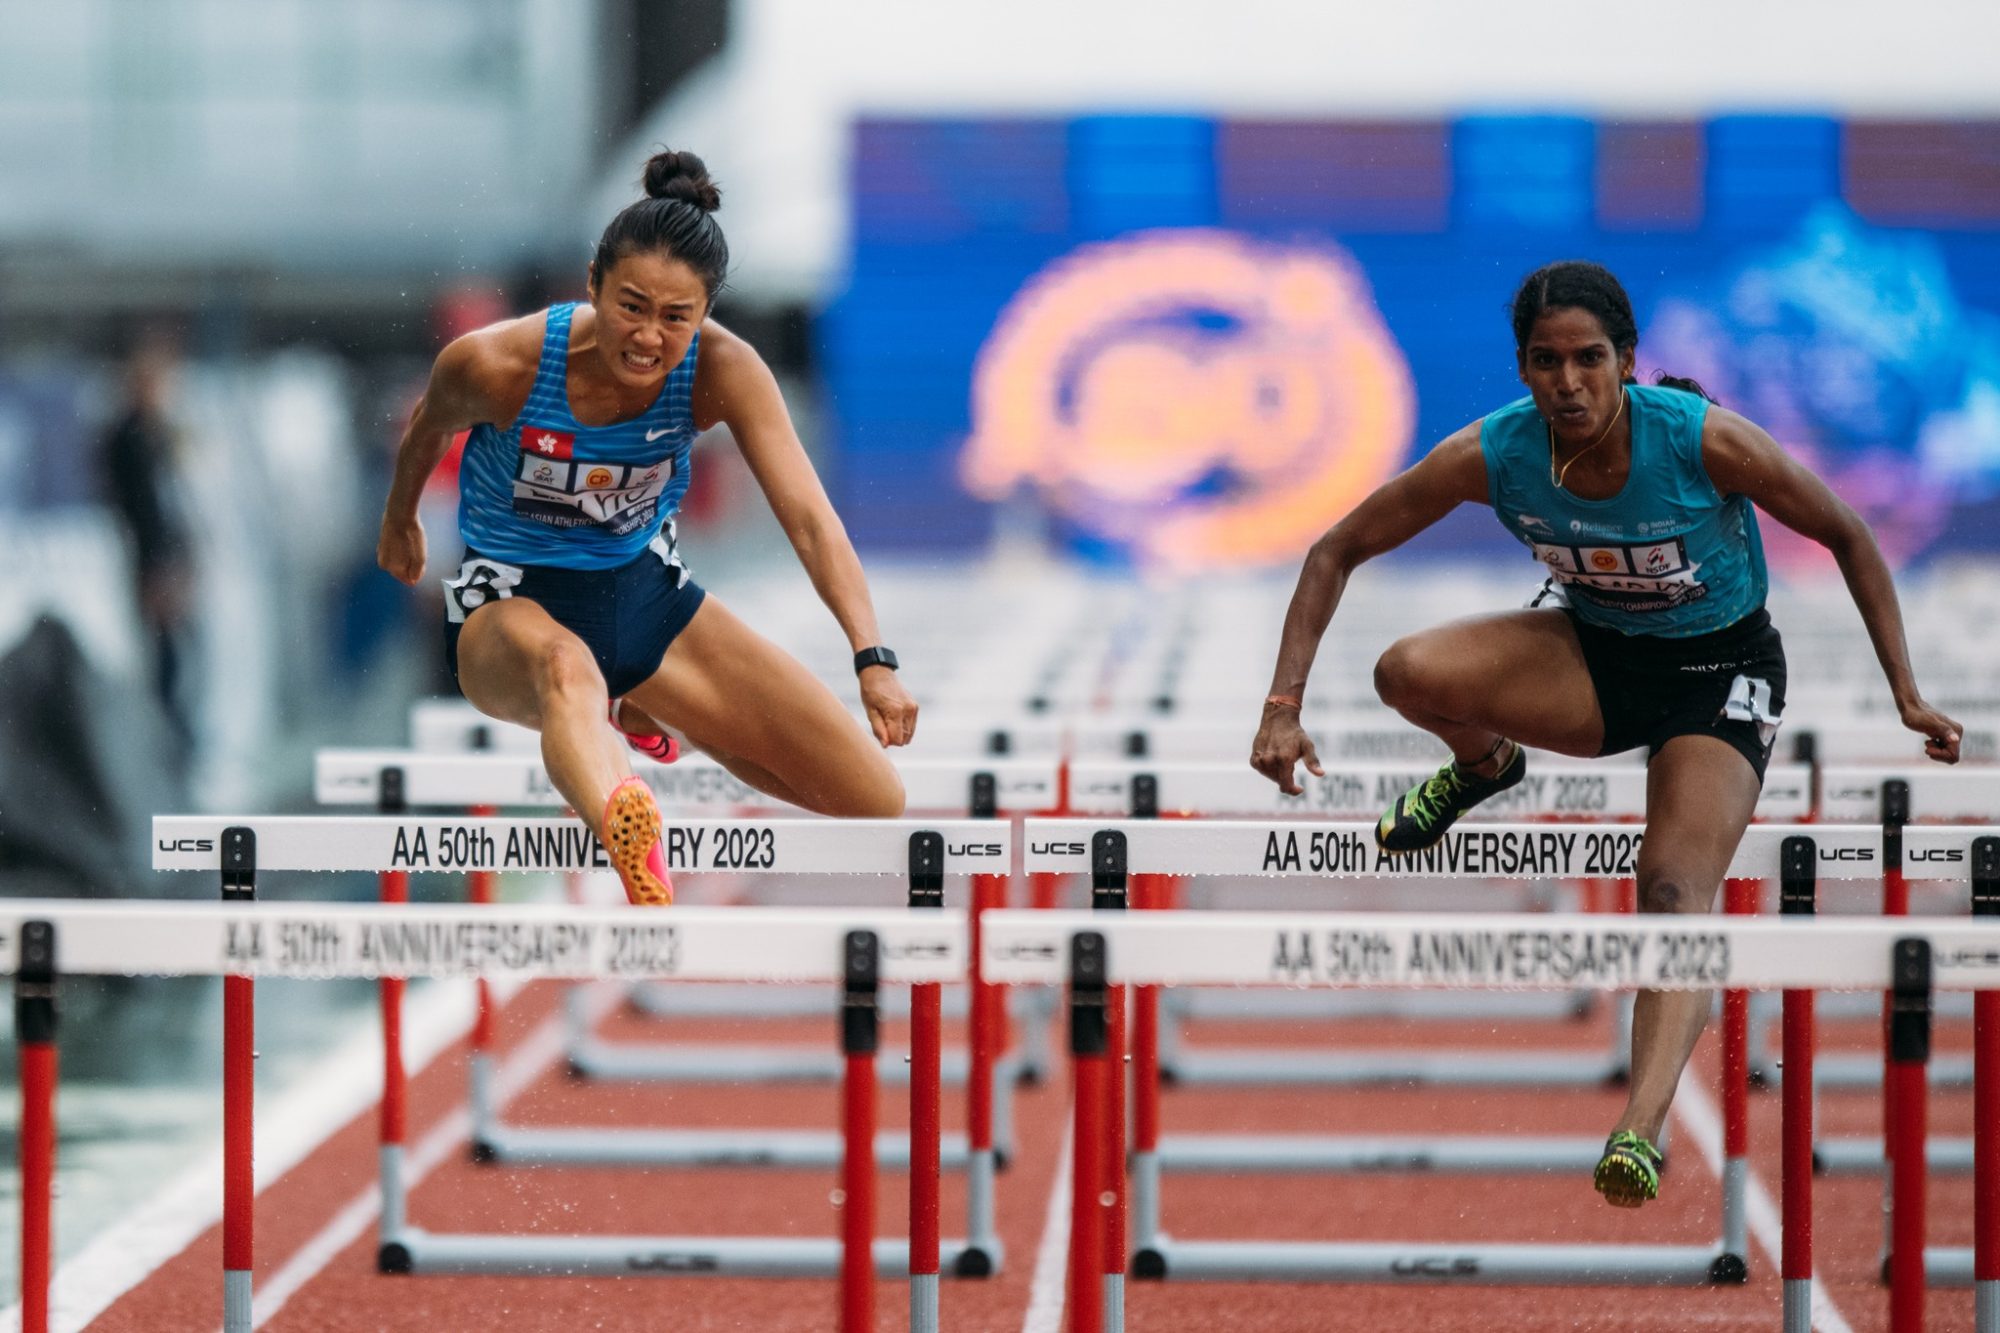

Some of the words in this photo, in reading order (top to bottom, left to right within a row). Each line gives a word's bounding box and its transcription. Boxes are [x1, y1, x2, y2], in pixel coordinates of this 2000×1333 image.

[589, 473, 610, 485] CP
[529, 512, 554, 525] ASIAN
[553, 514, 593, 528] ATHLETICS
[1595, 555, 1614, 567] CP
[159, 839, 213, 852] UCS
[392, 827, 429, 866] AA
[438, 827, 494, 866] 50th
[504, 826, 704, 867] ANNIVERY
[713, 827, 774, 868] 2023
[948, 843, 1002, 856] UCS
[1031, 842, 1086, 855] UCS
[1263, 831, 1301, 871] AA
[1310, 832, 1365, 872] 50th
[1819, 848, 1874, 861] UCS
[1909, 849, 1964, 862] UCS
[362, 922, 592, 973] ANNIVERSARY
[609, 924, 678, 974] 2023
[1407, 930, 1642, 981] ANNIVERSARY
[1657, 933, 1731, 983] 2023
